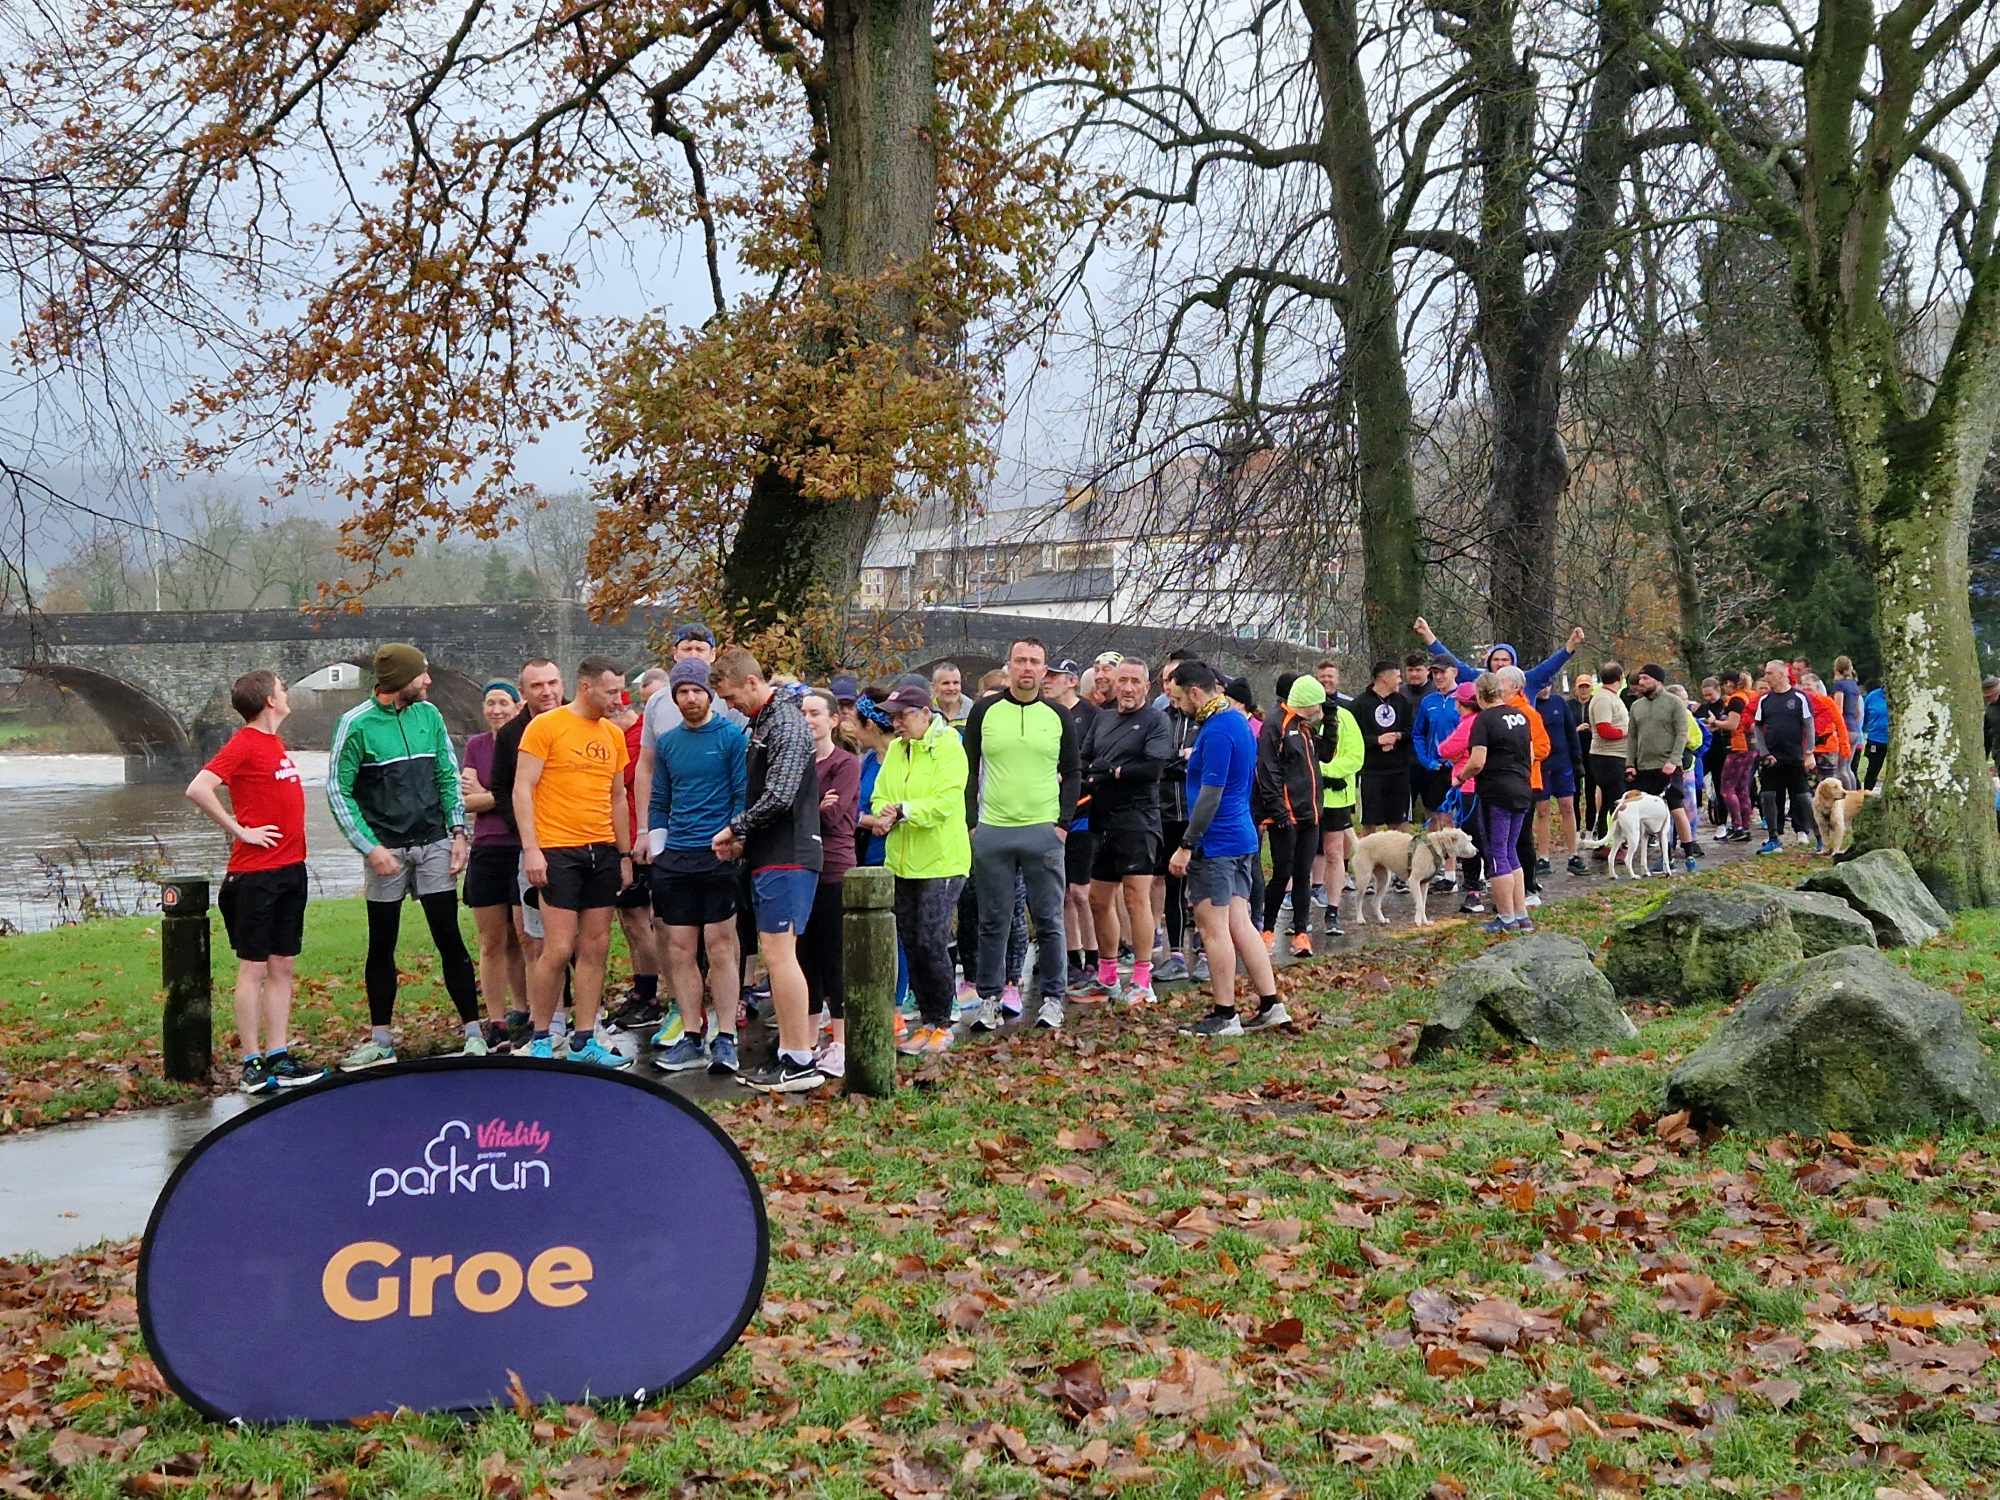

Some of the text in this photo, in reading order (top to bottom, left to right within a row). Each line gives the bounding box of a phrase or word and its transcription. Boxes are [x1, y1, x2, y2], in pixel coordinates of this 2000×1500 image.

[1502, 713, 1526, 730] 100
[368, 1120, 550, 1206] parkrun
[477, 1118, 551, 1153] Vitality
[322, 1241, 593, 1321] Groe
